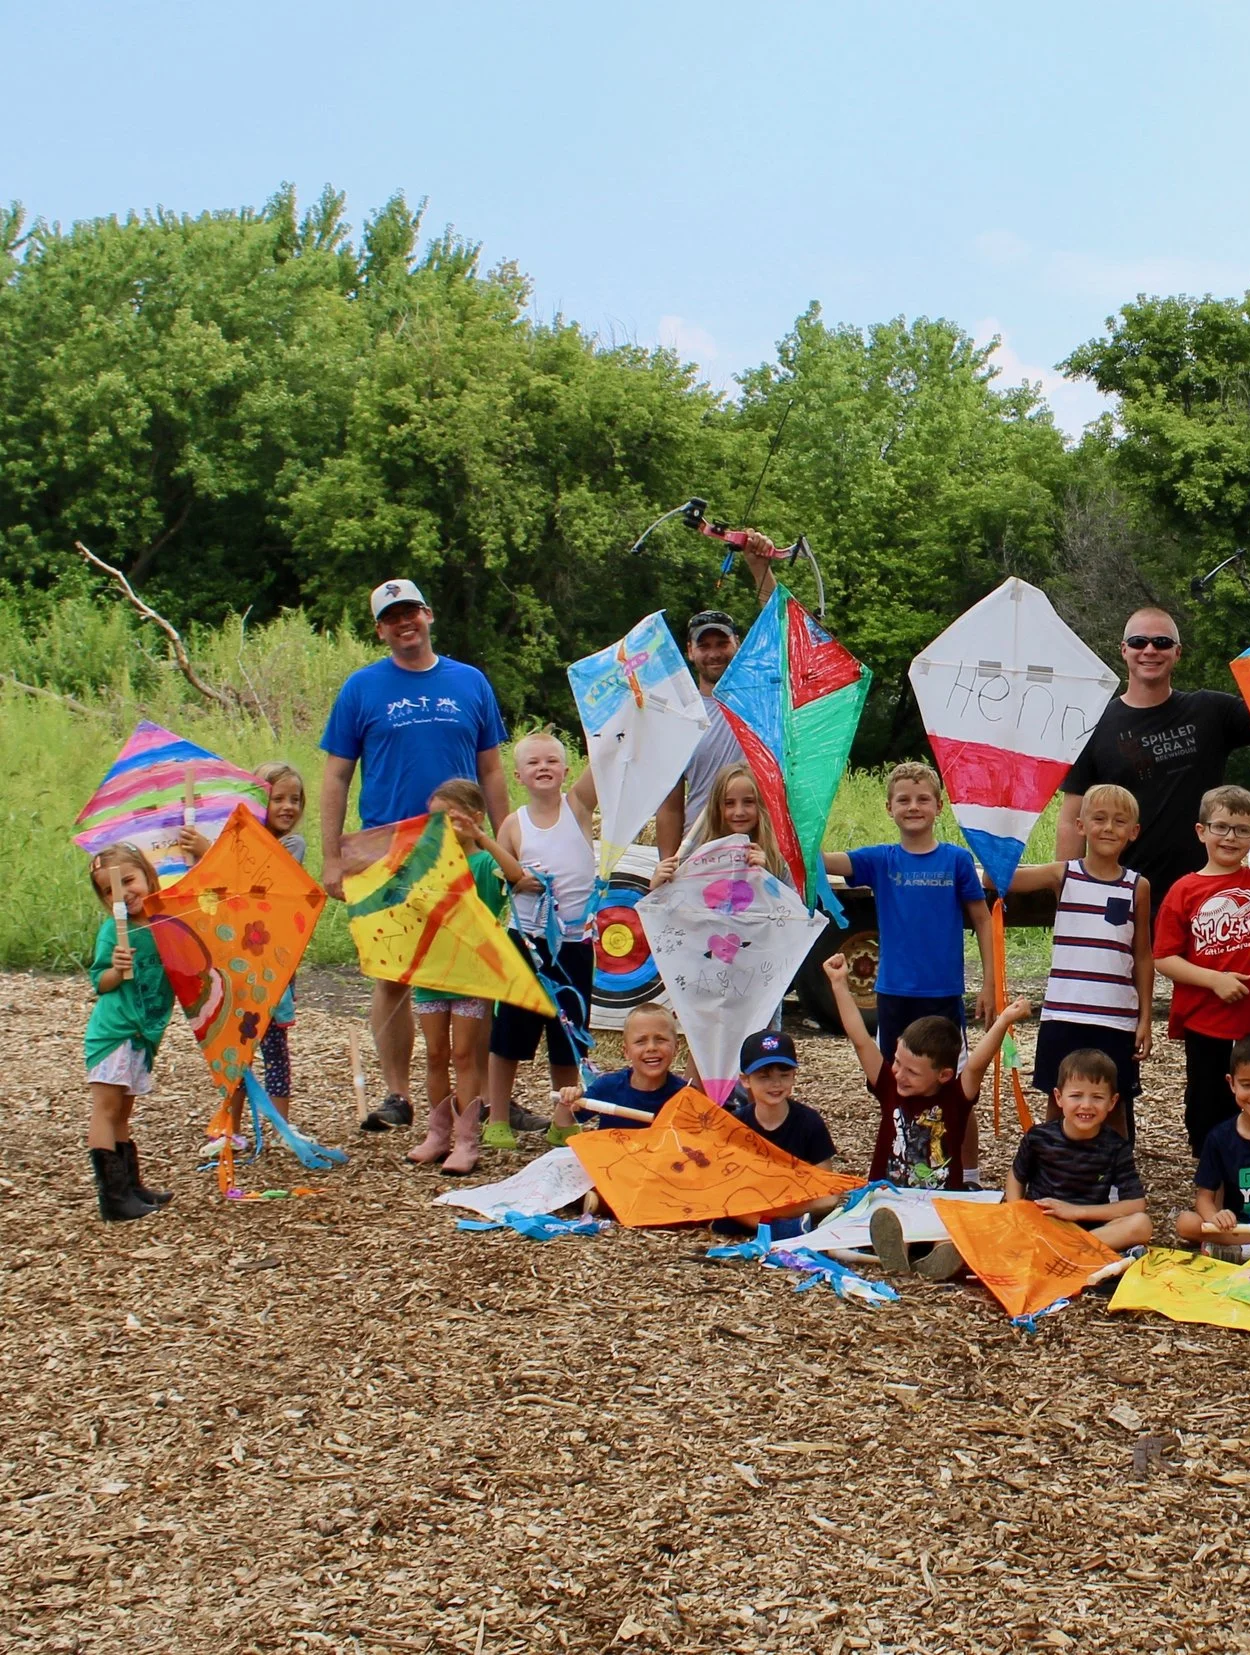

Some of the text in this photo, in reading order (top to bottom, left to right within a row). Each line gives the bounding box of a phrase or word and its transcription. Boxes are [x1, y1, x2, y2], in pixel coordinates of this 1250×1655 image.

[1141, 724, 1196, 747] SPILLED
[1152, 736, 1196, 755] GRAN
[903, 879, 954, 887] ARMOUR
